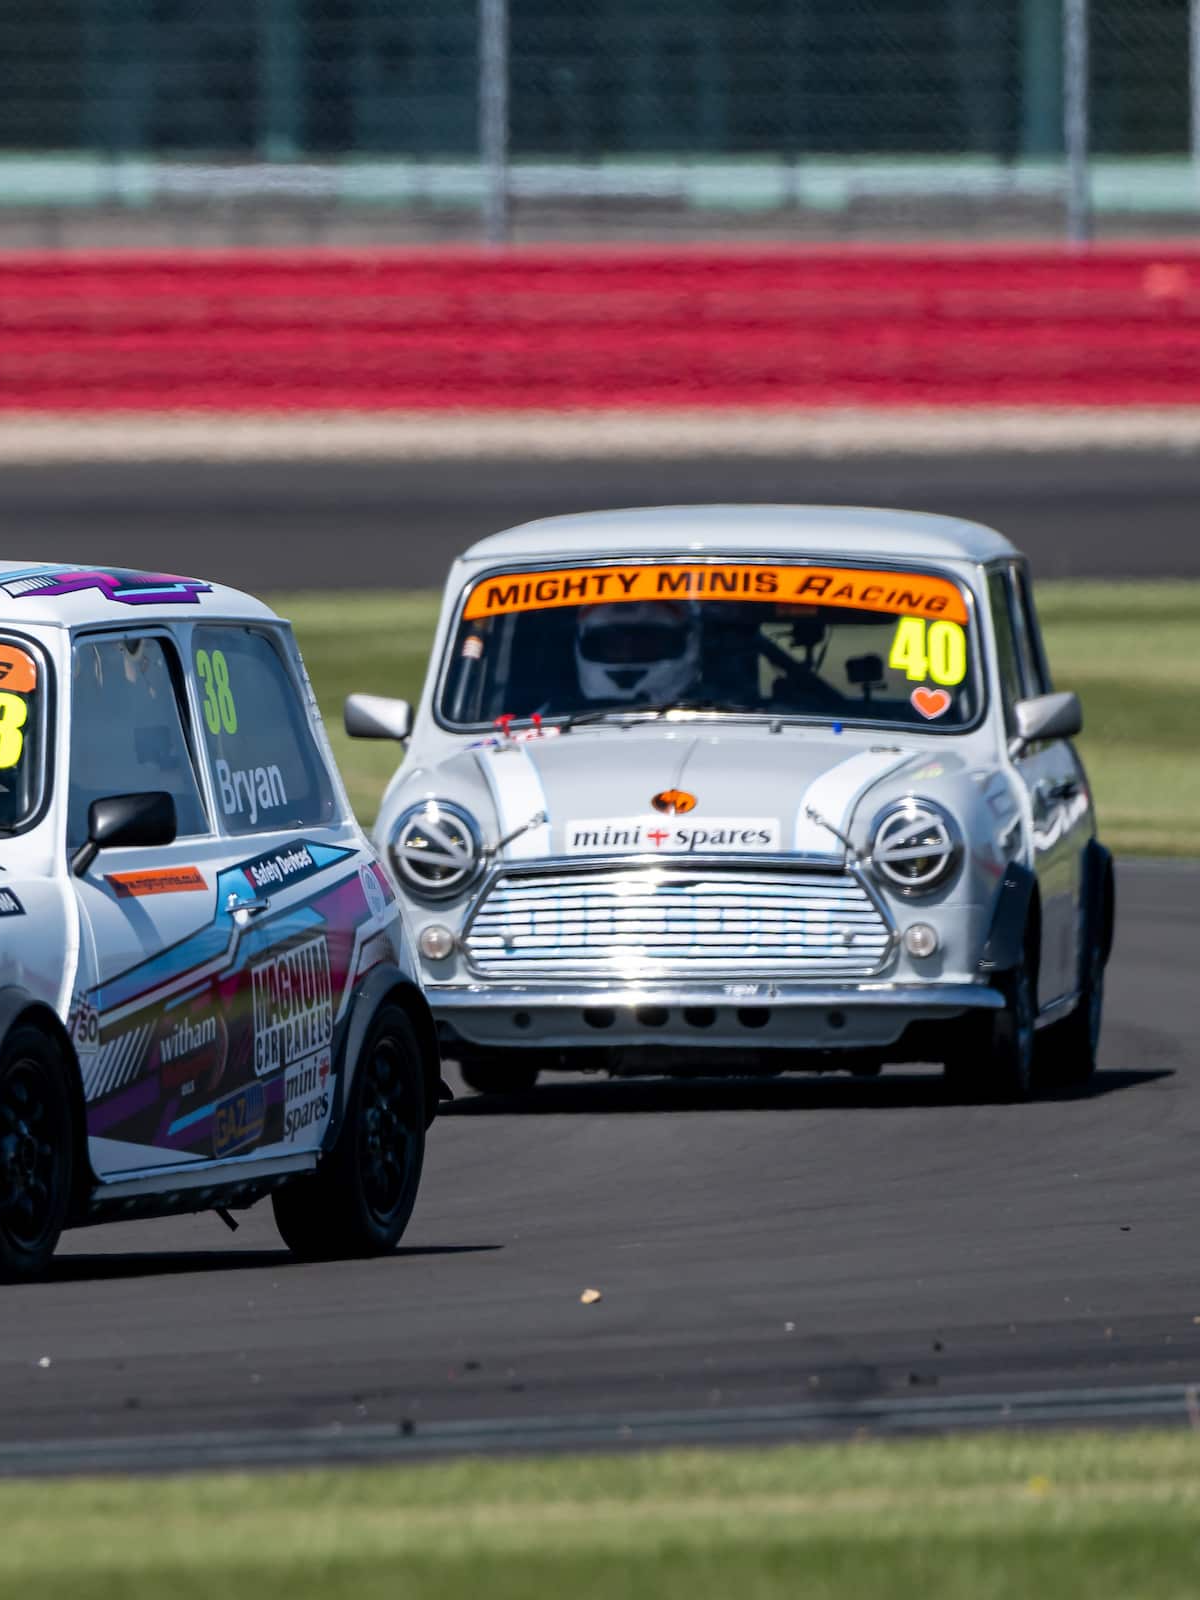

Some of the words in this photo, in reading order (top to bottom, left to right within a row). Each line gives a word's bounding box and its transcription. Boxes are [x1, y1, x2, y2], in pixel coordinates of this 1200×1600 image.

[486, 573, 641, 609] MIGHTY
[657, 571, 779, 594] MINIS
[796, 575, 949, 613] RACING
[889, 616, 967, 686] 40
[196, 649, 238, 735] 38
[215, 759, 288, 825] Bryan
[572, 825, 641, 847] mini
[674, 826, 772, 852] spares
[250, 860, 284, 887] Safety
[275, 845, 313, 875] Devices
[252, 938, 333, 1034] MAGNUM
[160, 1015, 217, 1064] witham
[256, 1028, 280, 1071] CAR
[286, 1056, 318, 1101] mini
[285, 1092, 329, 1142] spares
